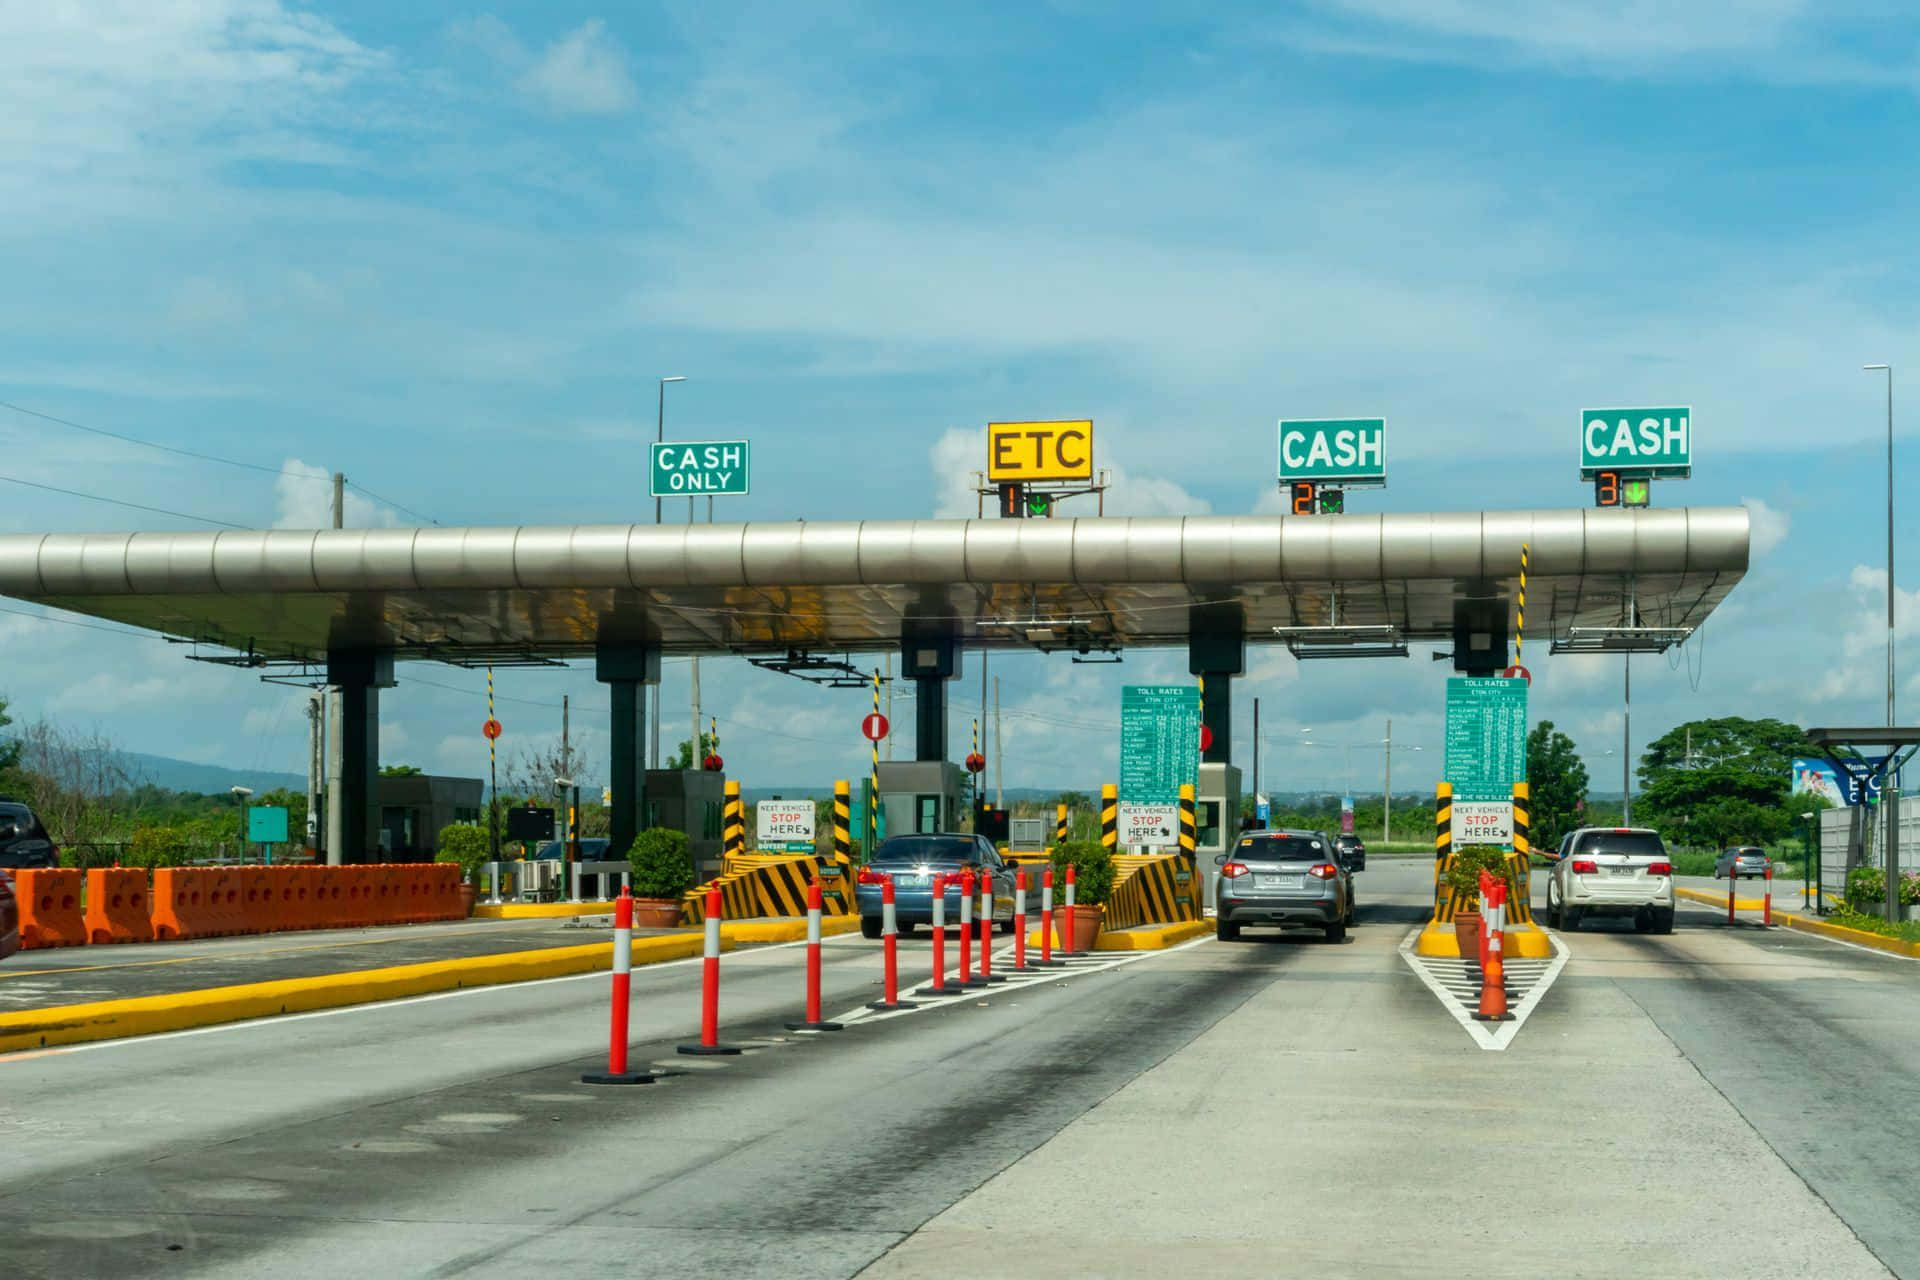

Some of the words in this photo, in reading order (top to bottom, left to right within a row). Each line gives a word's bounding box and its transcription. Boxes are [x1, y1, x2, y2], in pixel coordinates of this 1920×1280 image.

[1585, 417, 1687, 457] CASH
[658, 446, 740, 470] CASH
[994, 430, 1086, 469] ETC
[1282, 430, 1382, 468] CASH
[670, 472, 732, 490] ONLY
[1600, 472, 1617, 505] 3
[1295, 484, 1313, 515] 2
[771, 813, 801, 822] STOP
[1132, 816, 1163, 825] STOP
[1466, 816, 1498, 825] STOP
[770, 825, 802, 833] HERE
[1128, 828, 1158, 837] HERE
[1464, 827, 1499, 836] HERE
